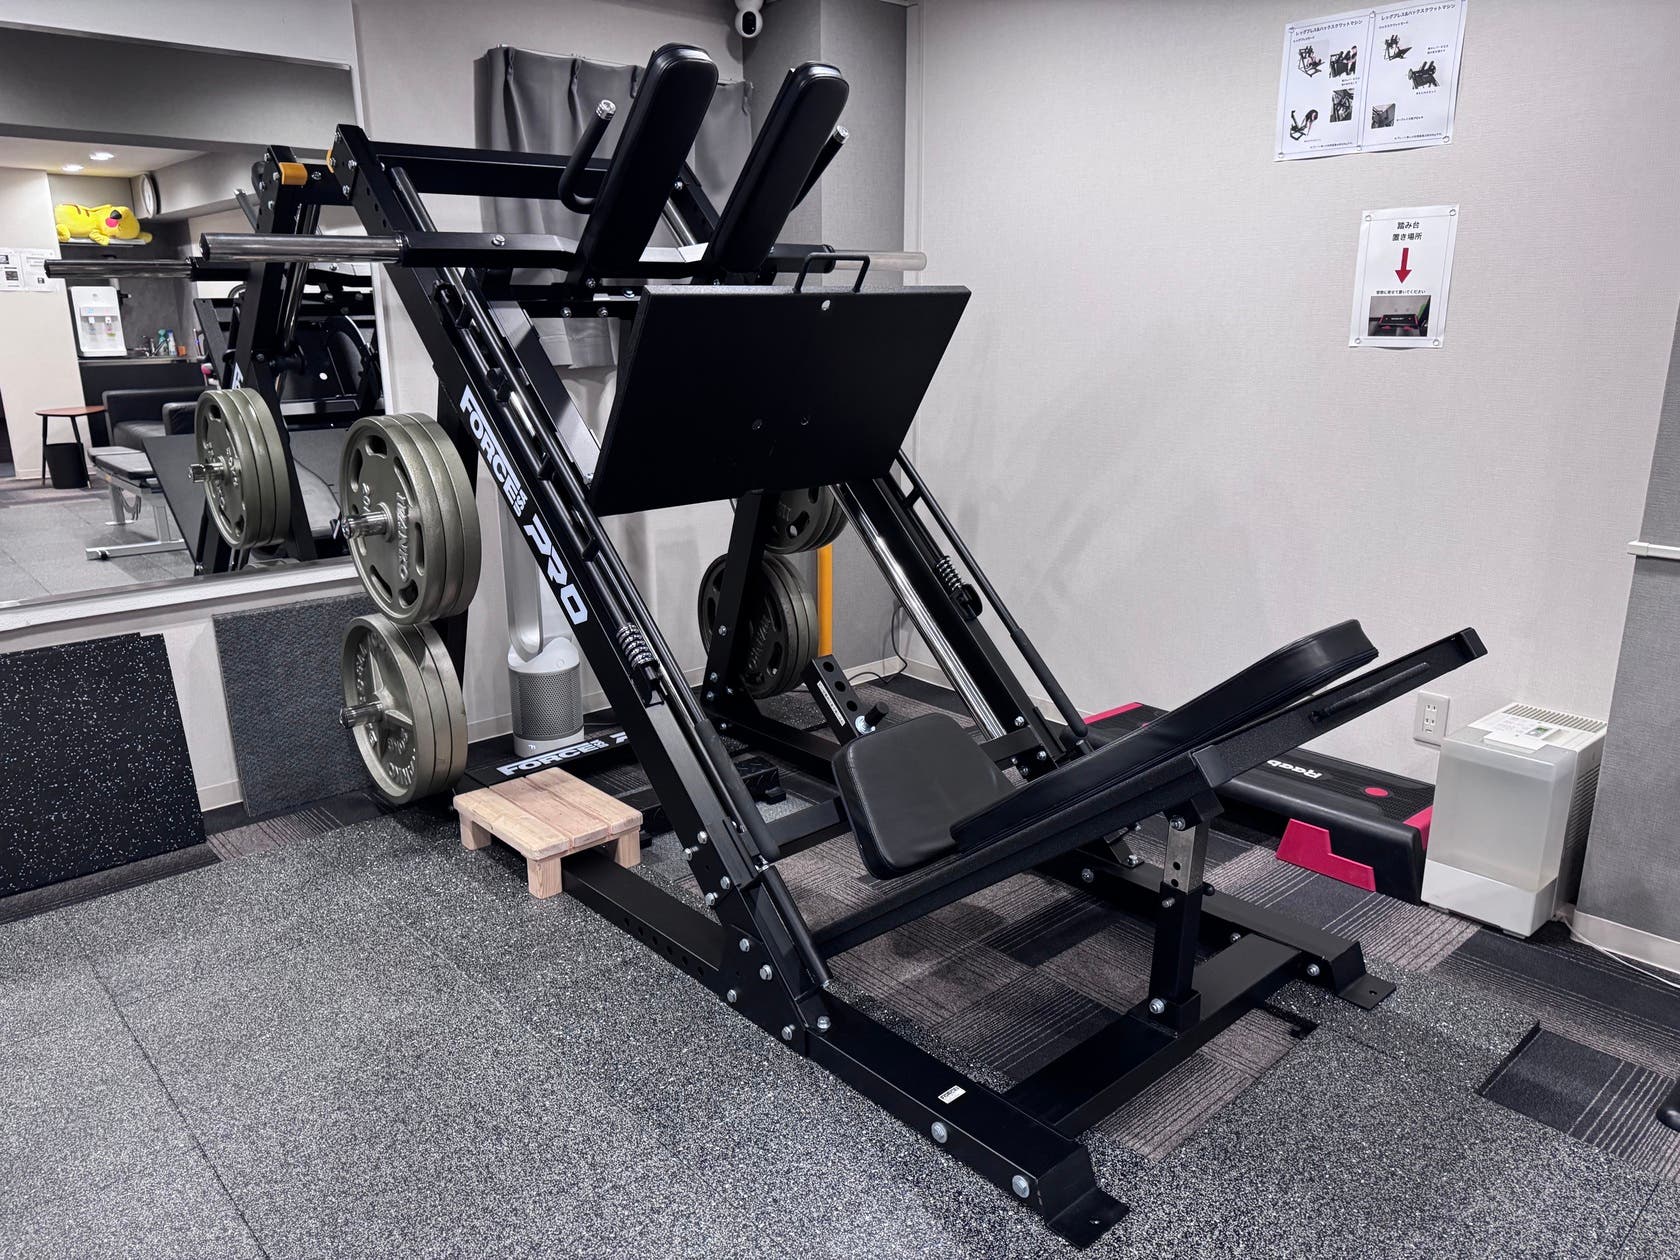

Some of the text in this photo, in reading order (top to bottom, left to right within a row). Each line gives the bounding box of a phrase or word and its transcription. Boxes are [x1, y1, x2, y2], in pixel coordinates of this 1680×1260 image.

[1397, 221, 1420, 230] 踏み台
[1392, 232, 1423, 241] 置き場所
[459, 384, 522, 506] FORCE
[523, 513, 588, 625] PRO
[496, 741, 600, 776] FORCE
[1266, 759, 1323, 779] Reeb
